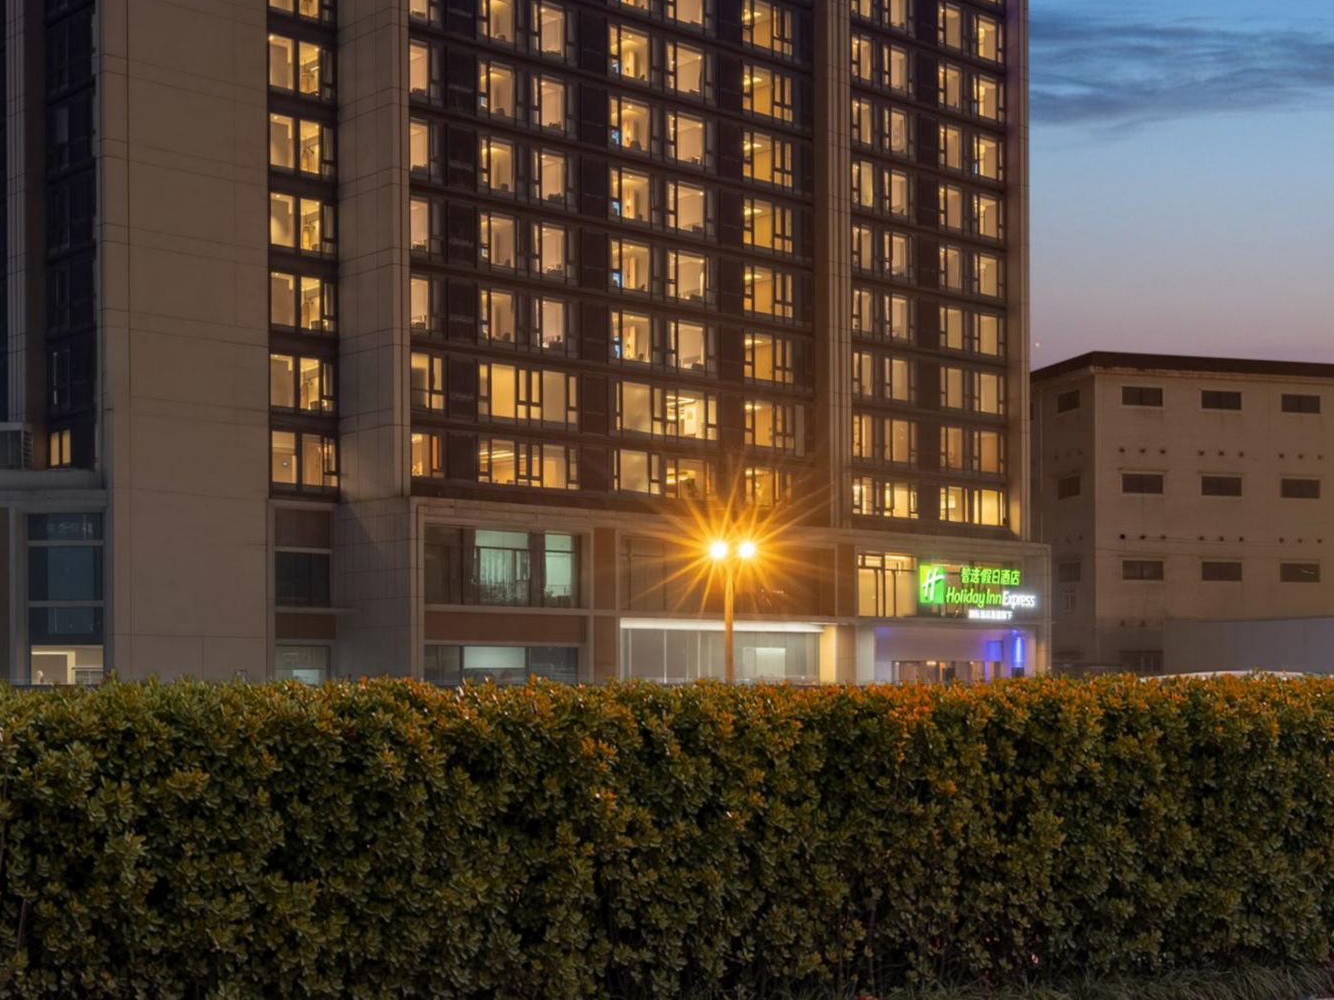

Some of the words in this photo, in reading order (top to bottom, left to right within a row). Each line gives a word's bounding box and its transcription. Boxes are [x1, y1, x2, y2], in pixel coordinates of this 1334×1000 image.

[946, 586, 986, 608] Holiday
[986, 588, 1002, 604] Inn
[1002, 591, 1036, 609] Express
